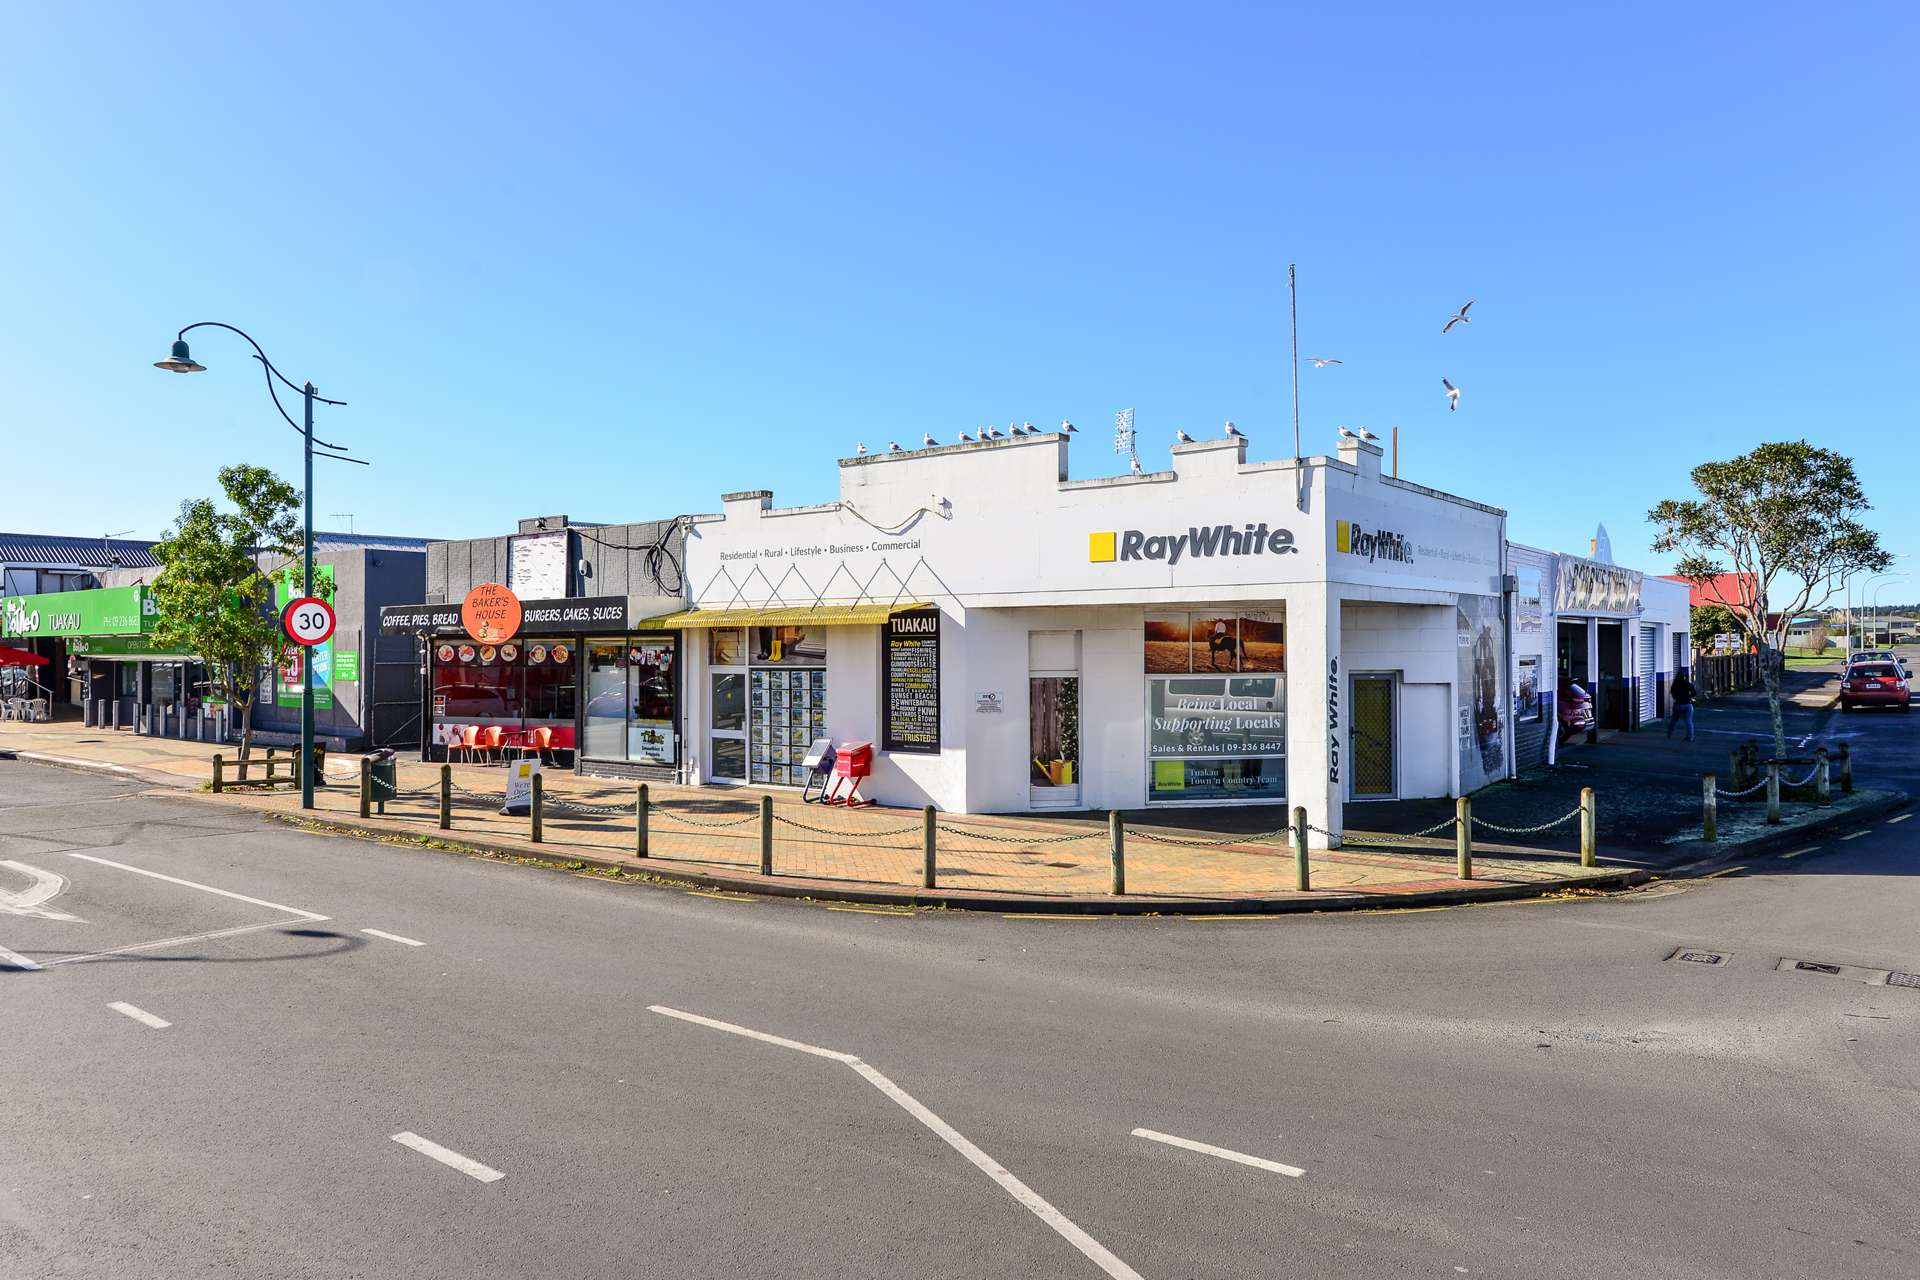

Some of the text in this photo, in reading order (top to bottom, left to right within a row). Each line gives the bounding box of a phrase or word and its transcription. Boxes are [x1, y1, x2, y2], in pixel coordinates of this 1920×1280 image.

[720, 539, 921, 561] Residential Rural Lifestyle Business Commercial
[480, 585, 497, 596] THE
[472, 597, 509, 608] BAKER'S
[48, 613, 81, 630] TUAKAU
[299, 613, 324, 630] 30
[382, 612, 459, 627] COFFEE, PIES, BREAD
[475, 609, 507, 620] HOUSE
[524, 606, 623, 623] BURGERS, CAKES, SLICES
[890, 618, 936, 633] TUAKAU
[891, 640, 902, 648] Ray
[1328, 656, 1340, 729] White.
[921, 706, 937, 715] KIWI
[1178, 698, 1258, 713] Being Local
[1153, 716, 1282, 733] Supporting Locals
[904, 733, 931, 742] TRUSTED
[1152, 744, 1177, 753] Sales
[1178, 744, 1185, 752] &
[1187, 743, 1219, 753] Rentals
[1260, 742, 1282, 751] 8447
[1329, 734, 1340, 784] Ray
[1190, 777, 1213, 786] Town
